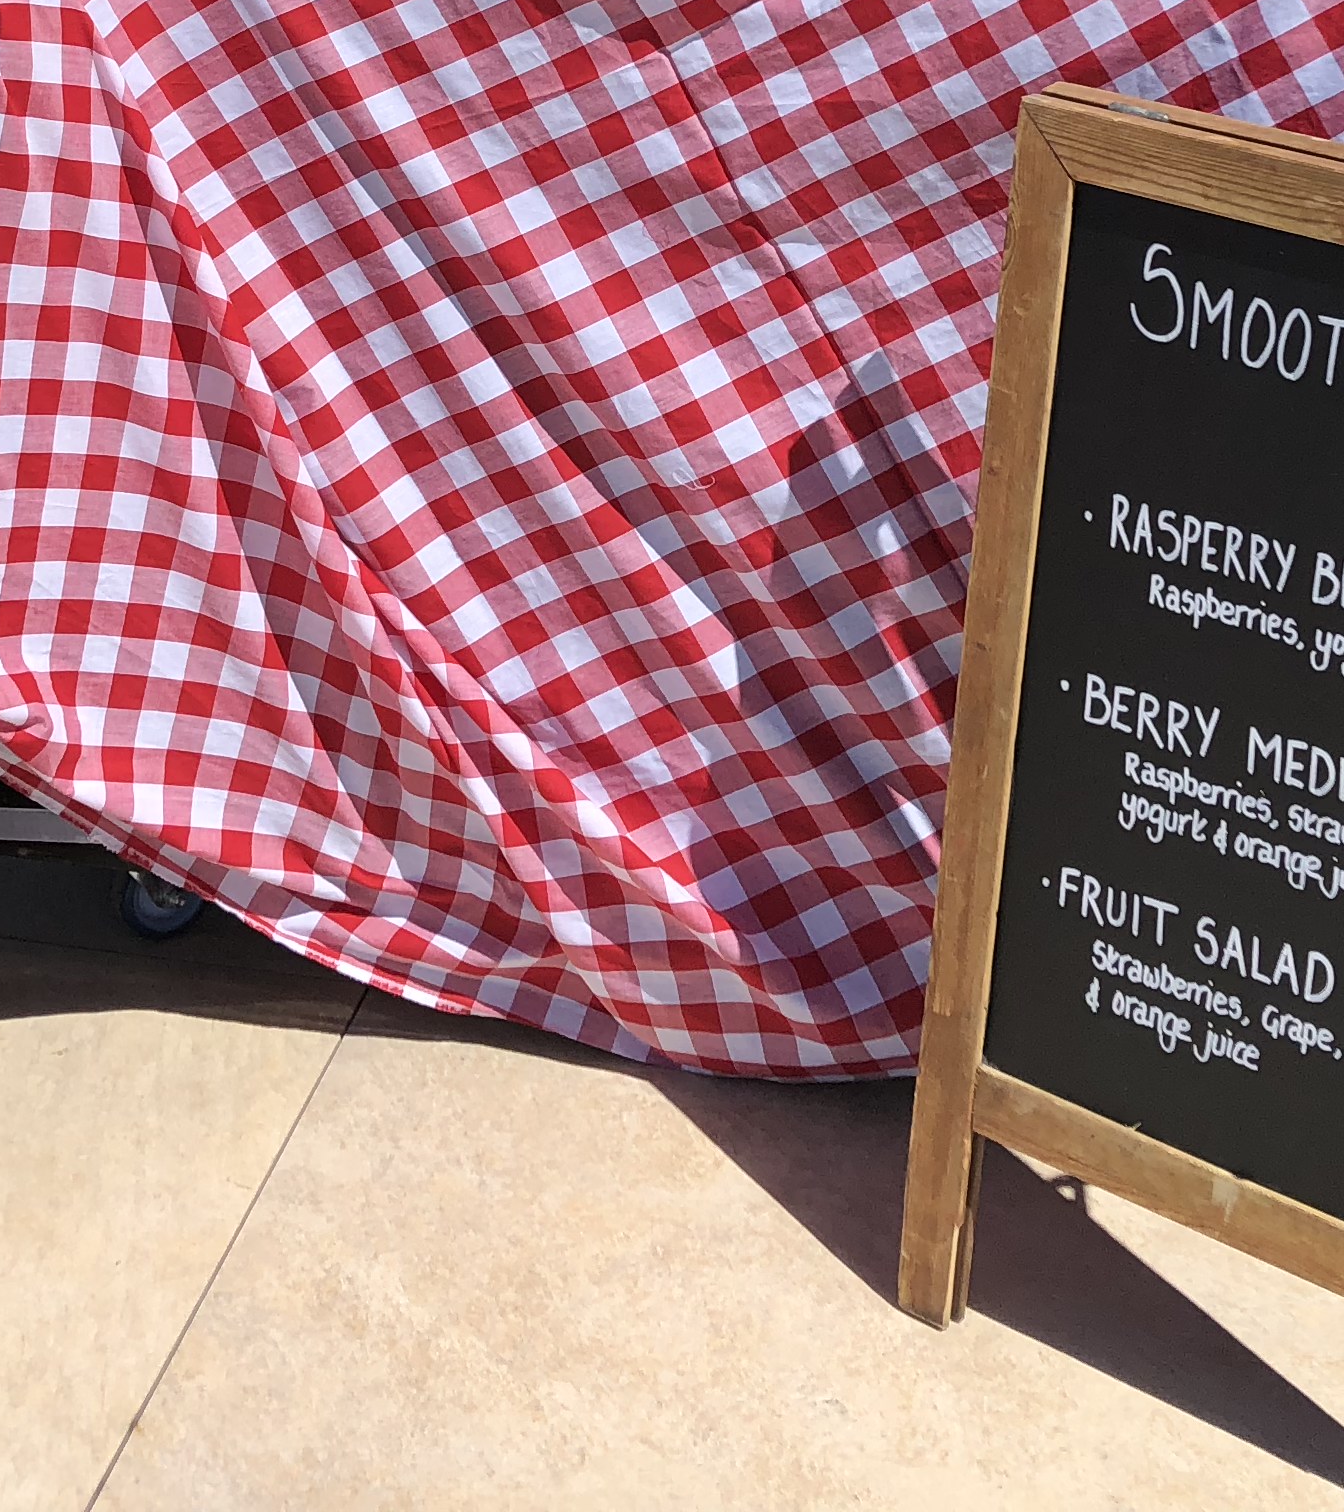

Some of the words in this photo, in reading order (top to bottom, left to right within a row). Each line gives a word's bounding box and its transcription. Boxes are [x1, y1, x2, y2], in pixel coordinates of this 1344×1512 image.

[1109, 493, 1297, 593] RASPERRY
[1083, 673, 1220, 757] BERRY
[1117, 790, 1209, 844] yogurt
[1212, 819, 1229, 856] &
[1233, 831, 1324, 891] orange
[1058, 867, 1180, 945] FRUIT
[1193, 915, 1336, 1003] SALAD
[1084, 976, 1101, 1014] &
[1111, 988, 1193, 1054] orange
[1192, 1021, 1261, 1072] juice
[1260, 1003, 1343, 1060] Grape,
